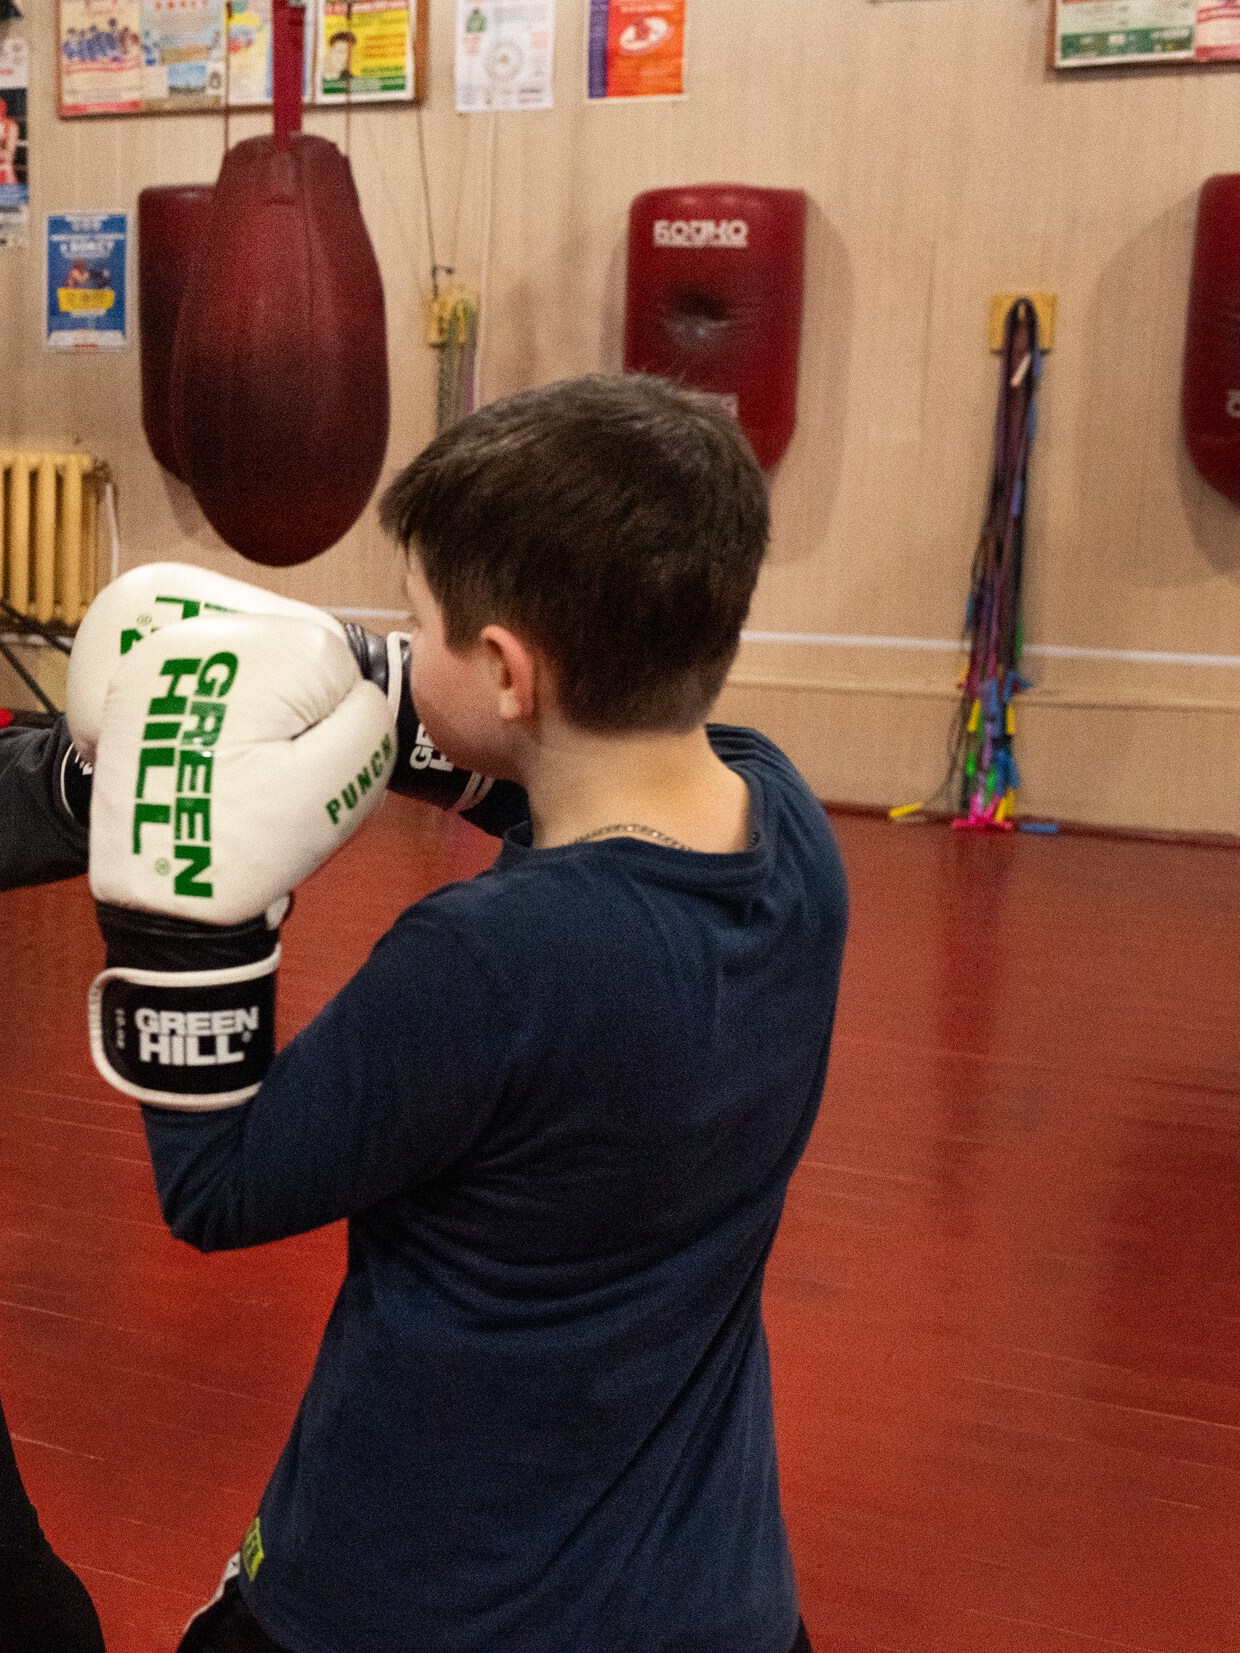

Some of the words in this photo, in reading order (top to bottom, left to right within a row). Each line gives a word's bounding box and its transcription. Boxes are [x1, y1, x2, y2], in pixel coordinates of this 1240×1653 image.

[132, 658, 203, 855] HILL
[171, 651, 239, 898] GREEN
[134, 1006, 259, 1036] GREEN
[138, 1033, 245, 1066] HILL
